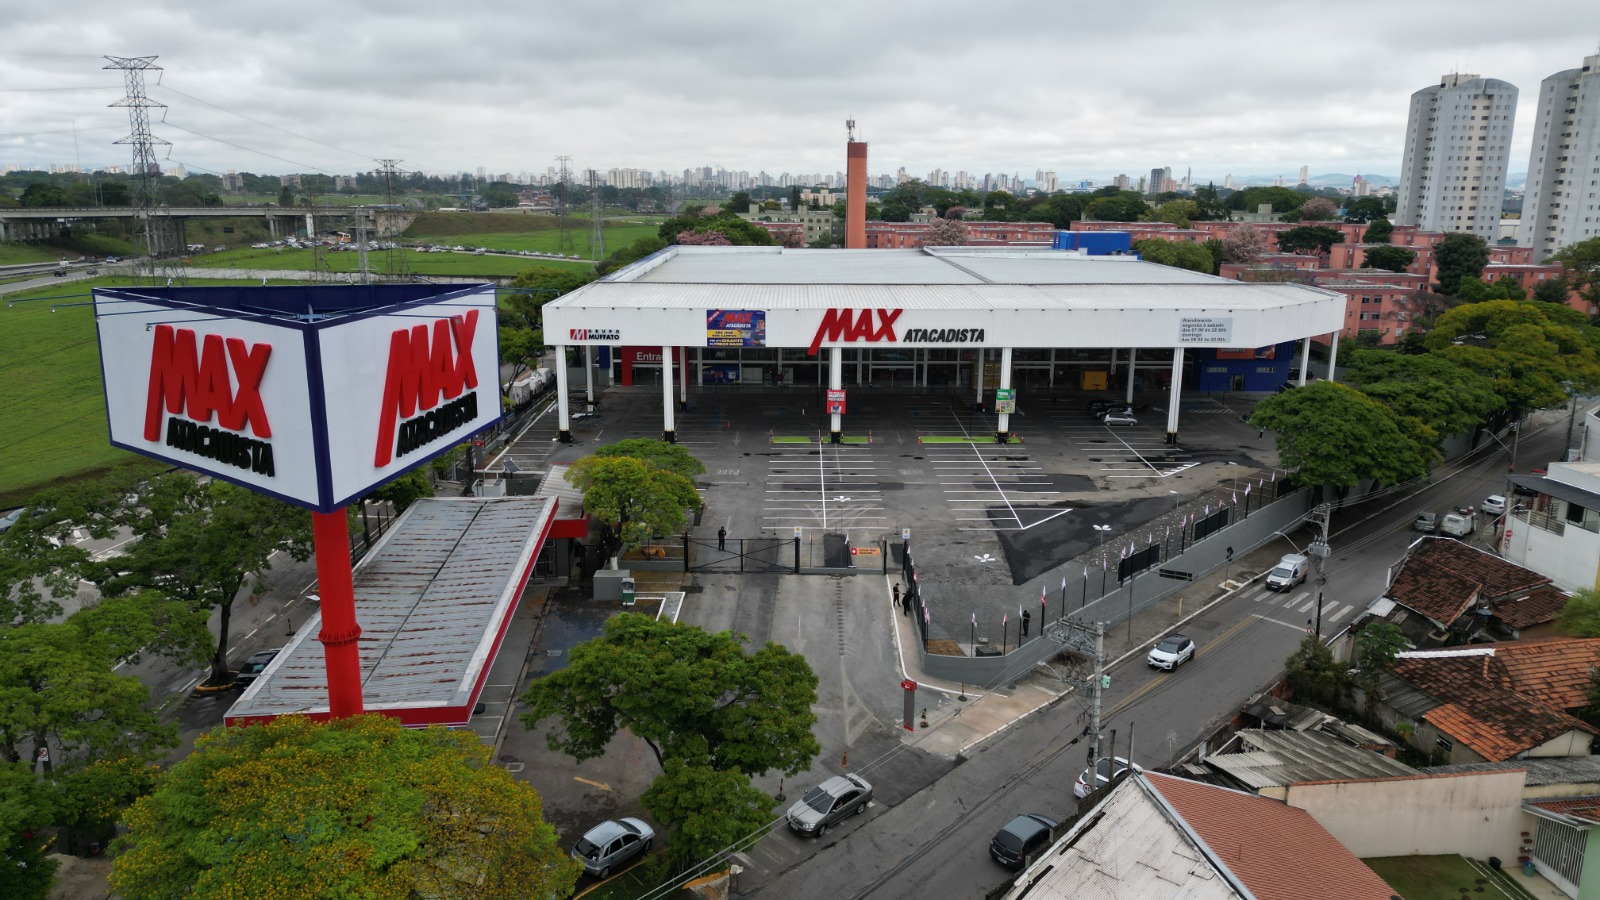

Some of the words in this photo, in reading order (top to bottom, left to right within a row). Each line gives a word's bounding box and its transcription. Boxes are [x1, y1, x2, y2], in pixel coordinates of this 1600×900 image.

[719, 312, 752, 327] MAX
[807, 308, 903, 356] MAX
[903, 329, 984, 342] ATACADISTA
[144, 325, 272, 442] MAX
[375, 309, 479, 468] MAX
[166, 417, 275, 477] ATACADISTA
[396, 391, 478, 457] ATACADISTA
